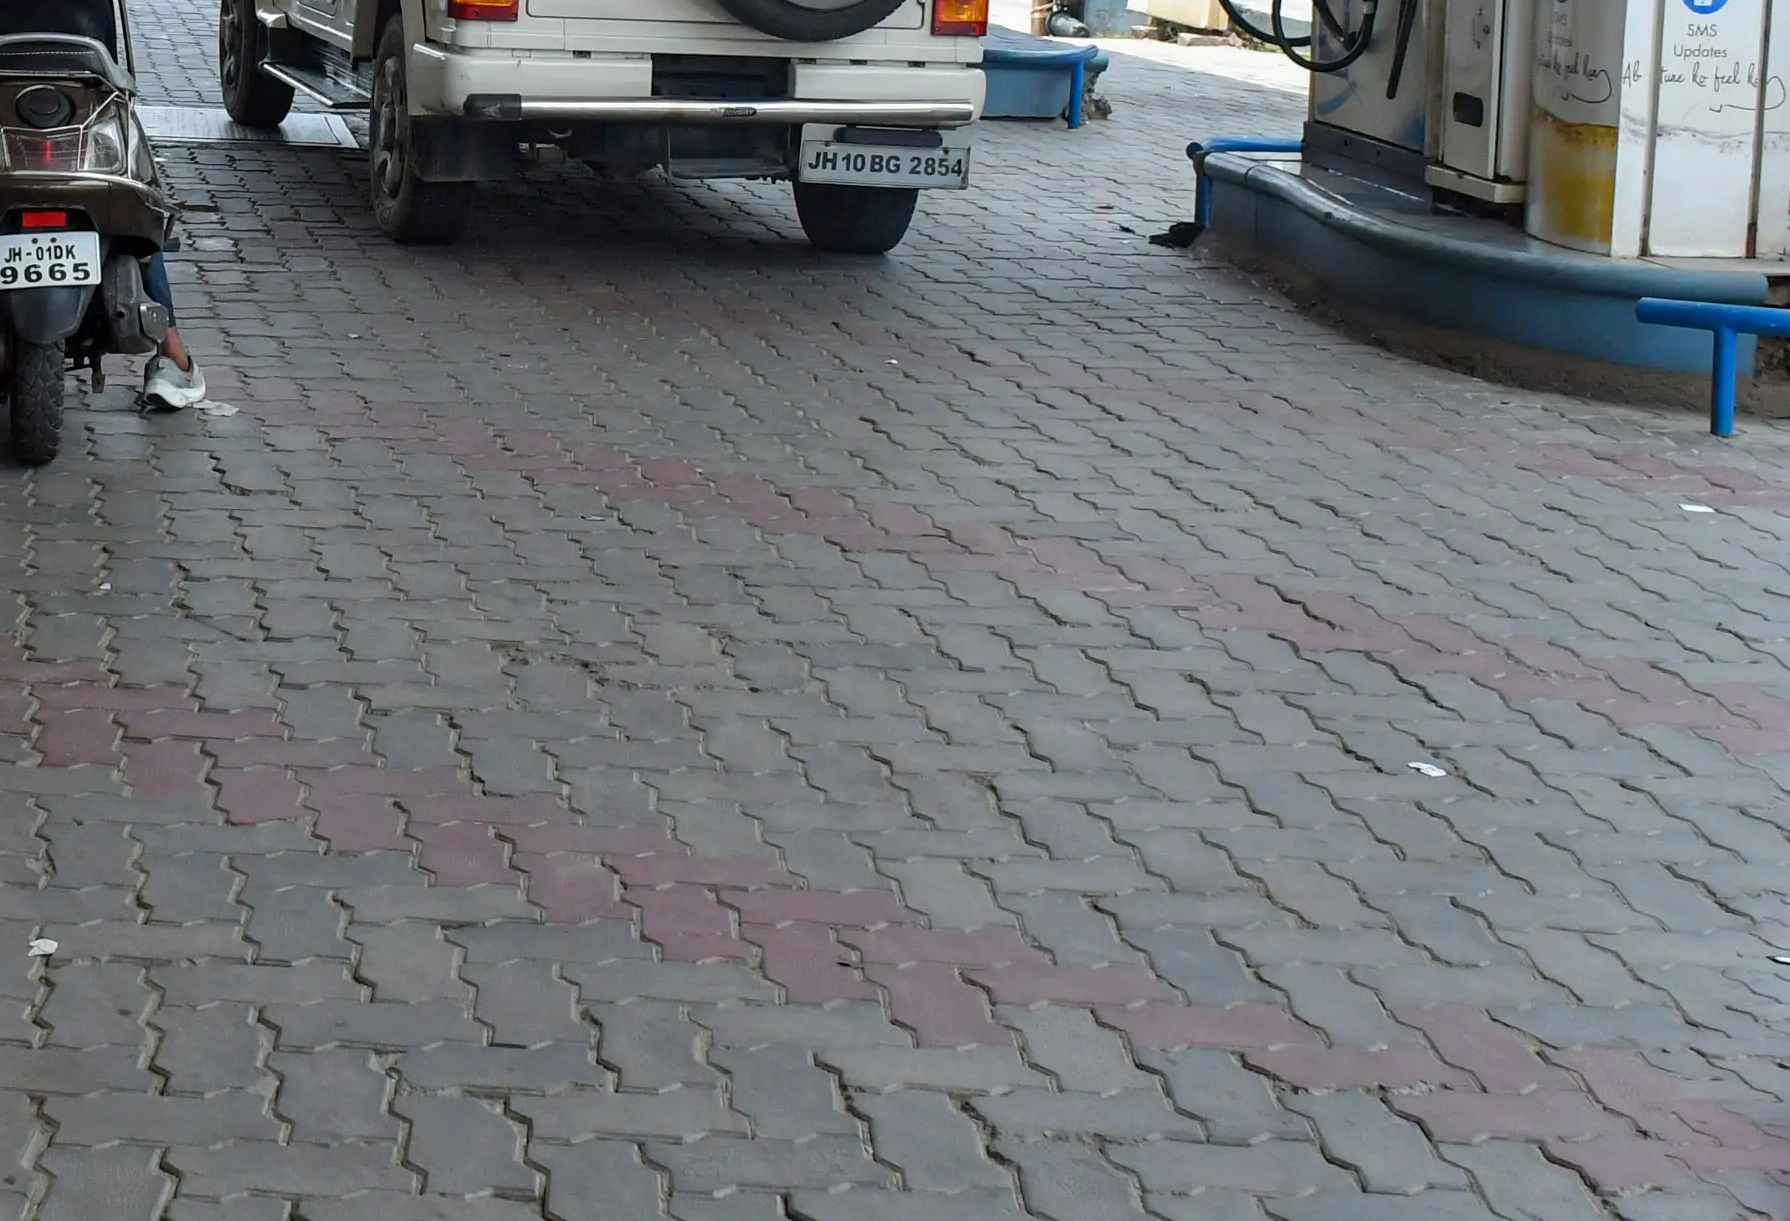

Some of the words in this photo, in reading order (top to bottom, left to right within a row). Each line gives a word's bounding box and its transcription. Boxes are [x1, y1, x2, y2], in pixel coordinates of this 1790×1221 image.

[1686, 23, 1718, 38] SMS
[1673, 44, 1728, 60] Updates
[808, 151, 901, 174] JH10BG
[908, 156, 963, 178] 2854
[0, 262, 91, 285] 9665
